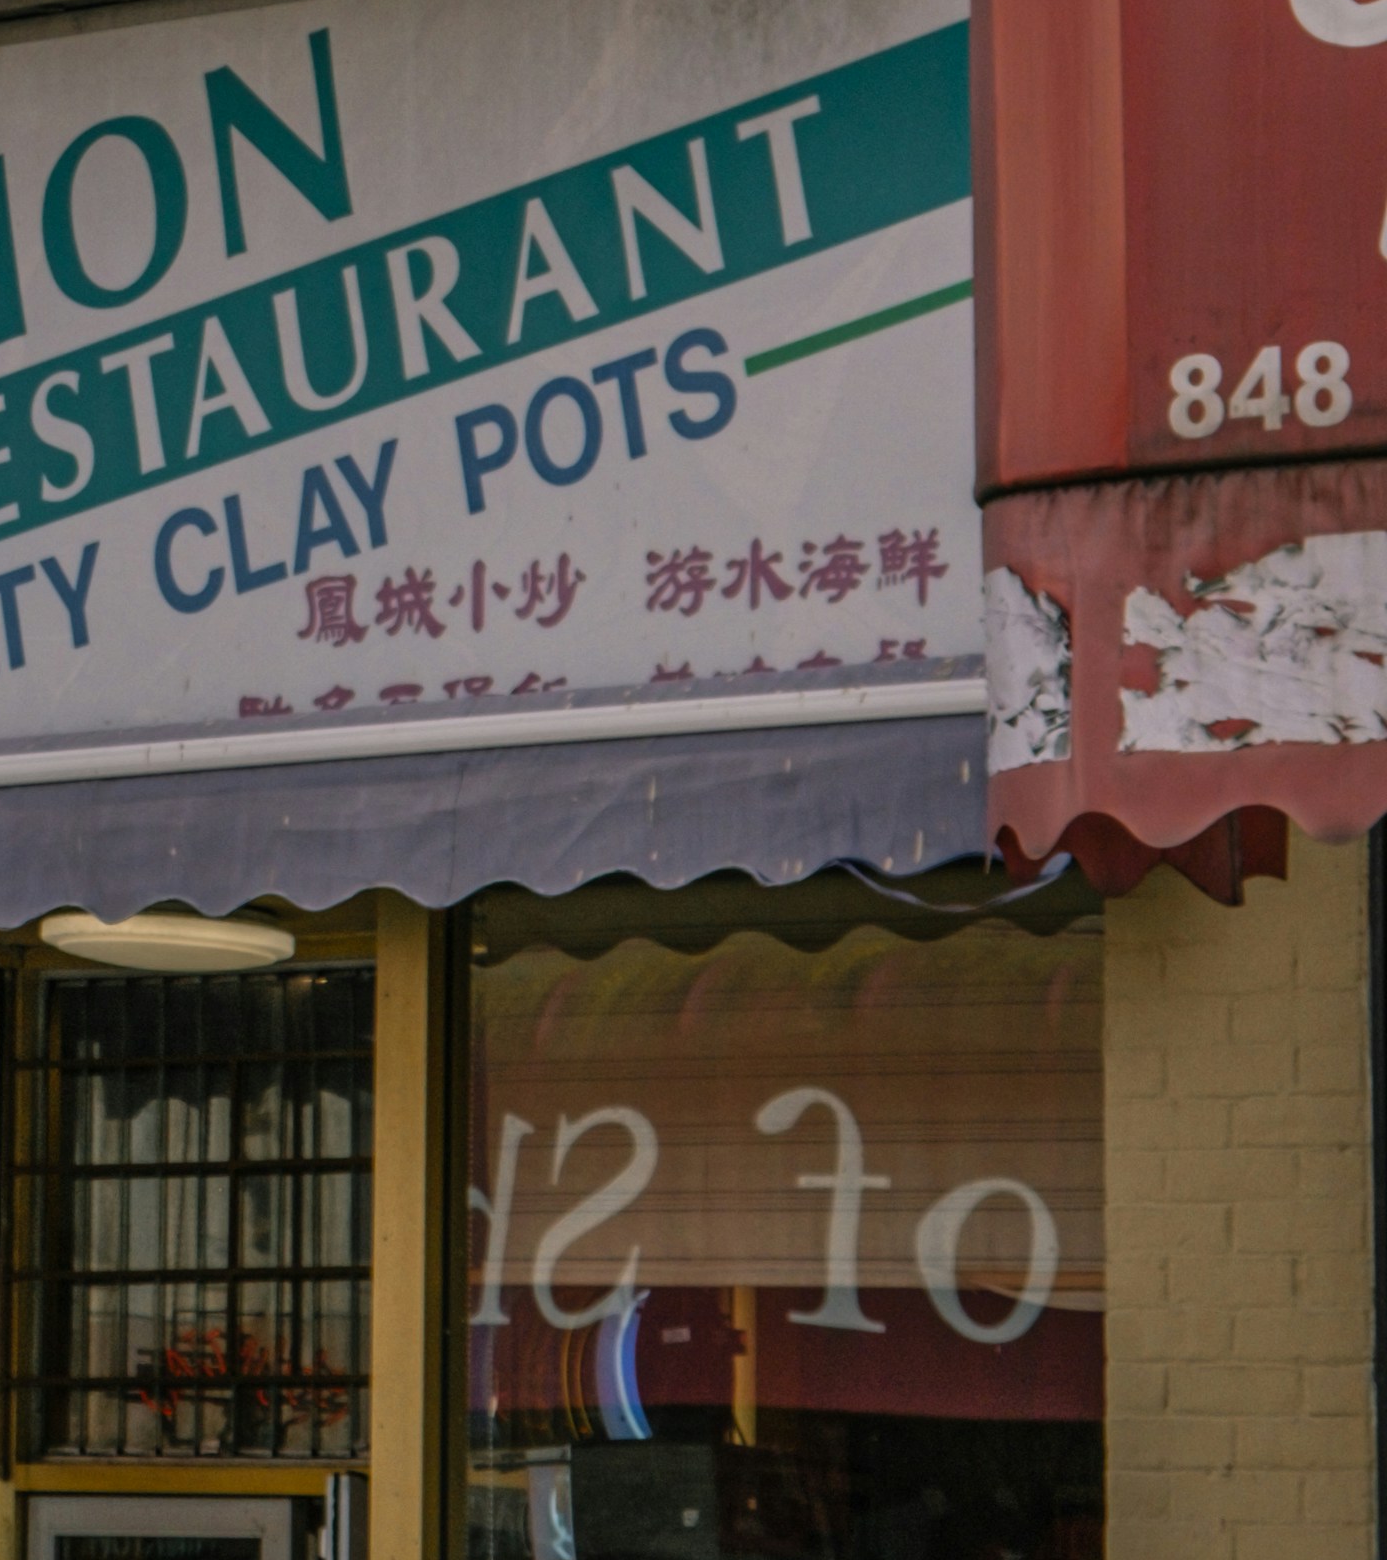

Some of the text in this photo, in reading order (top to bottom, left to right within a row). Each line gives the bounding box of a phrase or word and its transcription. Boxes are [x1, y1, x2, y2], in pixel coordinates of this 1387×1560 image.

[1168, 341, 1352, 439] 848
[153, 439, 399, 614] CLAY
[454, 327, 738, 514] POTS
[298, 552, 587, 648] 鳳城小炒
[644, 529, 949, 617] 游水海鮮
